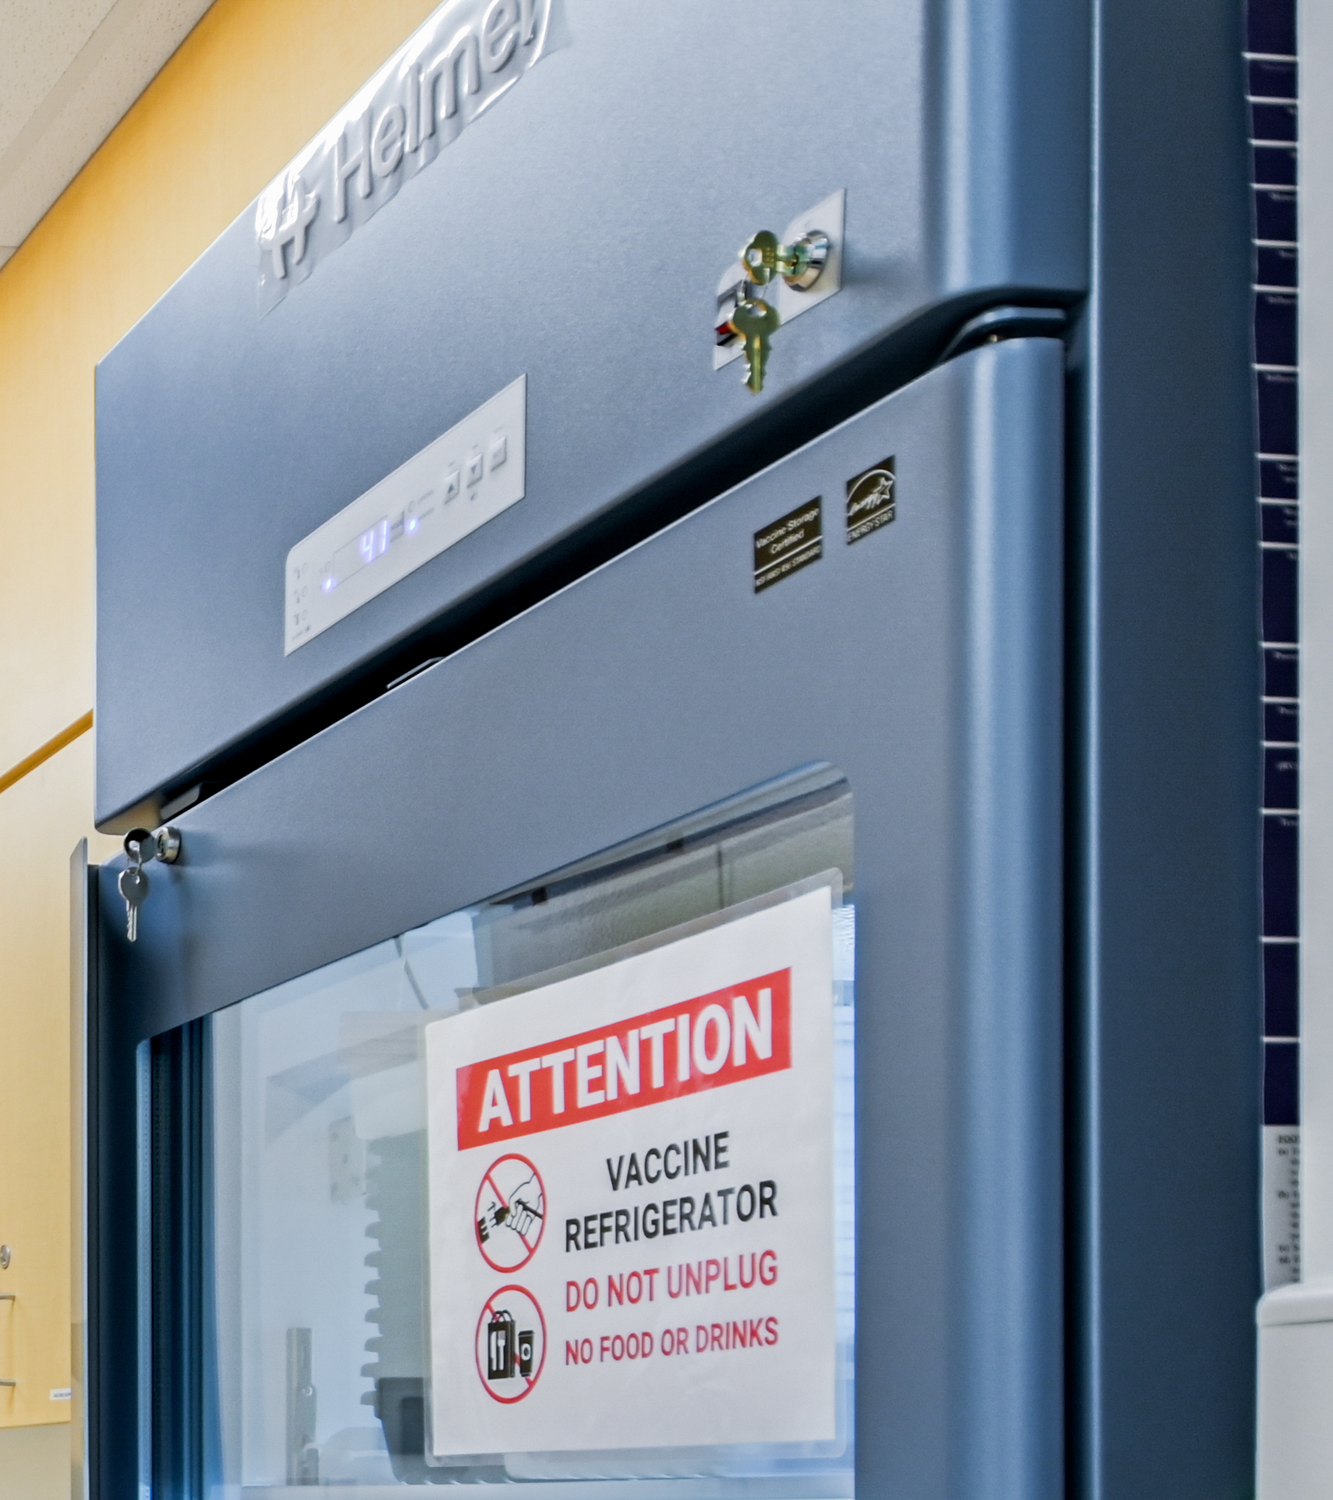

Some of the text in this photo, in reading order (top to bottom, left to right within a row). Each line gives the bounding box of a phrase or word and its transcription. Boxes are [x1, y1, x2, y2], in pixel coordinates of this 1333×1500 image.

[361, 519, 388, 563] 41
[756, 508, 820, 548] Vaccine Storage
[770, 530, 805, 555] Certified
[874, 510, 894, 527] STAR
[477, 988, 773, 1133] ATTENTION
[607, 1132, 730, 1191] VACCINE
[565, 1180, 778, 1252] REFRIGERATOR
[566, 1249, 778, 1312] DO NOT UNPLUG
[565, 1317, 778, 1366] NO FOOD OR DRINKS
